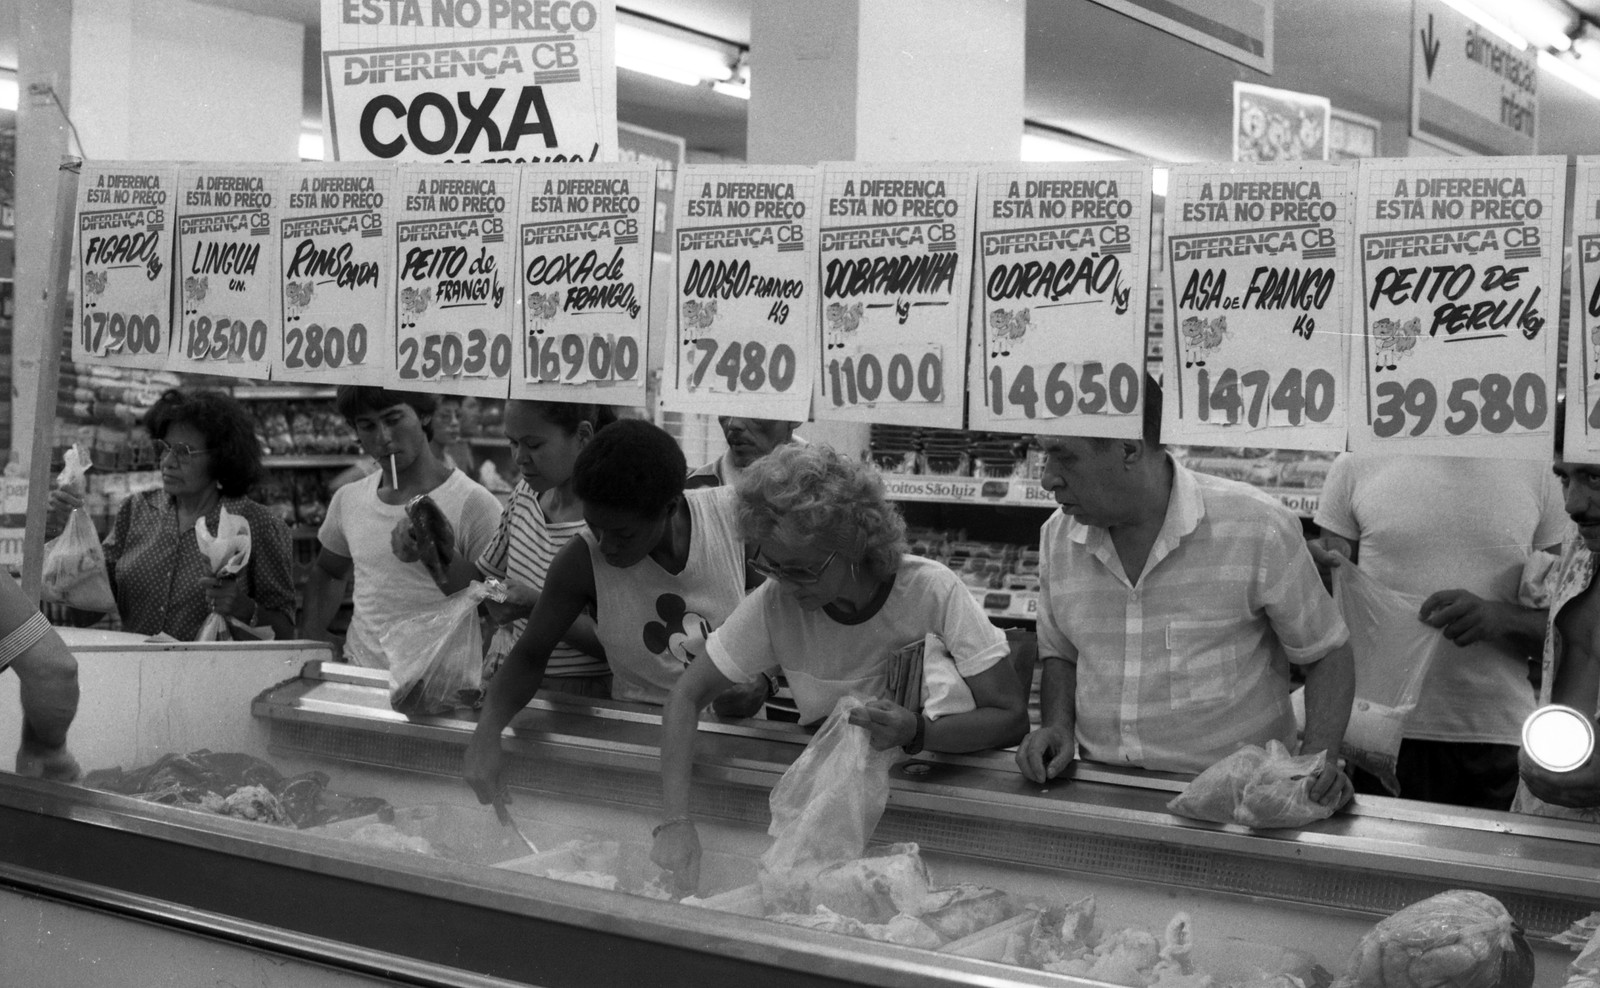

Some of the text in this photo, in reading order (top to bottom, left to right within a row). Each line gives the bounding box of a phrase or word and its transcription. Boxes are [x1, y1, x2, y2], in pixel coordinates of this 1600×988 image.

[432, 0, 481, 28] NO
[489, 0, 597, 33] PREÇO
[344, 42, 578, 85] DIFERENÇA CB
[360, 86, 558, 158] COXA
[97, 175, 104, 188] A
[196, 176, 204, 191] A
[300, 177, 309, 192] A
[418, 180, 426, 194] A
[544, 180, 552, 195] A
[701, 183, 711, 198] A
[844, 180, 855, 197] A
[1008, 181, 1020, 198] A
[1200, 182, 1213, 200] A
[1394, 179, 1409, 197] A
[114, 190, 130, 204] NO
[214, 192, 231, 207] NO
[320, 193, 339, 208] NO
[439, 196, 459, 211] NO
[567, 197, 588, 213] NO
[727, 201, 749, 217] NO
[872, 199, 897, 216] NO
[1039, 200, 1066, 218] NO
[1432, 199, 1463, 220] NO
[82, 210, 164, 230] DIFERENÇA CB
[181, 213, 270, 235] DIFERENÇA CB
[283, 214, 382, 239] DIFERENÇA CB
[1234, 202, 1264, 222] NO
[400, 219, 504, 242] DIFERENÇA CB
[524, 218, 638, 245] DIFERENÇA CB
[680, 225, 804, 251] DIFERENÇA CB
[822, 223, 956, 252] DIFERENÇA CB
[985, 225, 1130, 256] DIFERENÇA CB
[1174, 228, 1335, 262] DIFERENÇA CB
[1366, 226, 1540, 261] DIFERENÇA CB
[85, 231, 159, 266] FIGADO
[191, 240, 261, 275] LINGUA
[401, 246, 496, 280] PEITO de
[337, 261, 379, 290] CADA
[526, 246, 625, 286] COXA de
[683, 259, 804, 300] DORSO FRANGO
[824, 252, 959, 298] DOBRADINHA
[436, 278, 490, 303] FRANGO
[563, 283, 634, 312] FRANGO
[987, 252, 1131, 315] CORAÇÃO kg
[1179, 268, 1226, 310] ASA
[1242, 266, 1335, 311] FRANGO
[1370, 263, 1530, 309] PEITO DE
[1429, 299, 1515, 337] PERU
[83, 312, 161, 354] 17900
[187, 316, 267, 361] 18500
[285, 323, 368, 368] 2800
[399, 328, 512, 379] 25030
[529, 334, 639, 381] 16900
[694, 338, 796, 392] 7480
[829, 352, 943, 407] 11000
[989, 362, 1139, 419] 14650
[1197, 367, 1335, 428] 14740
[1373, 371, 1548, 438] 39580
